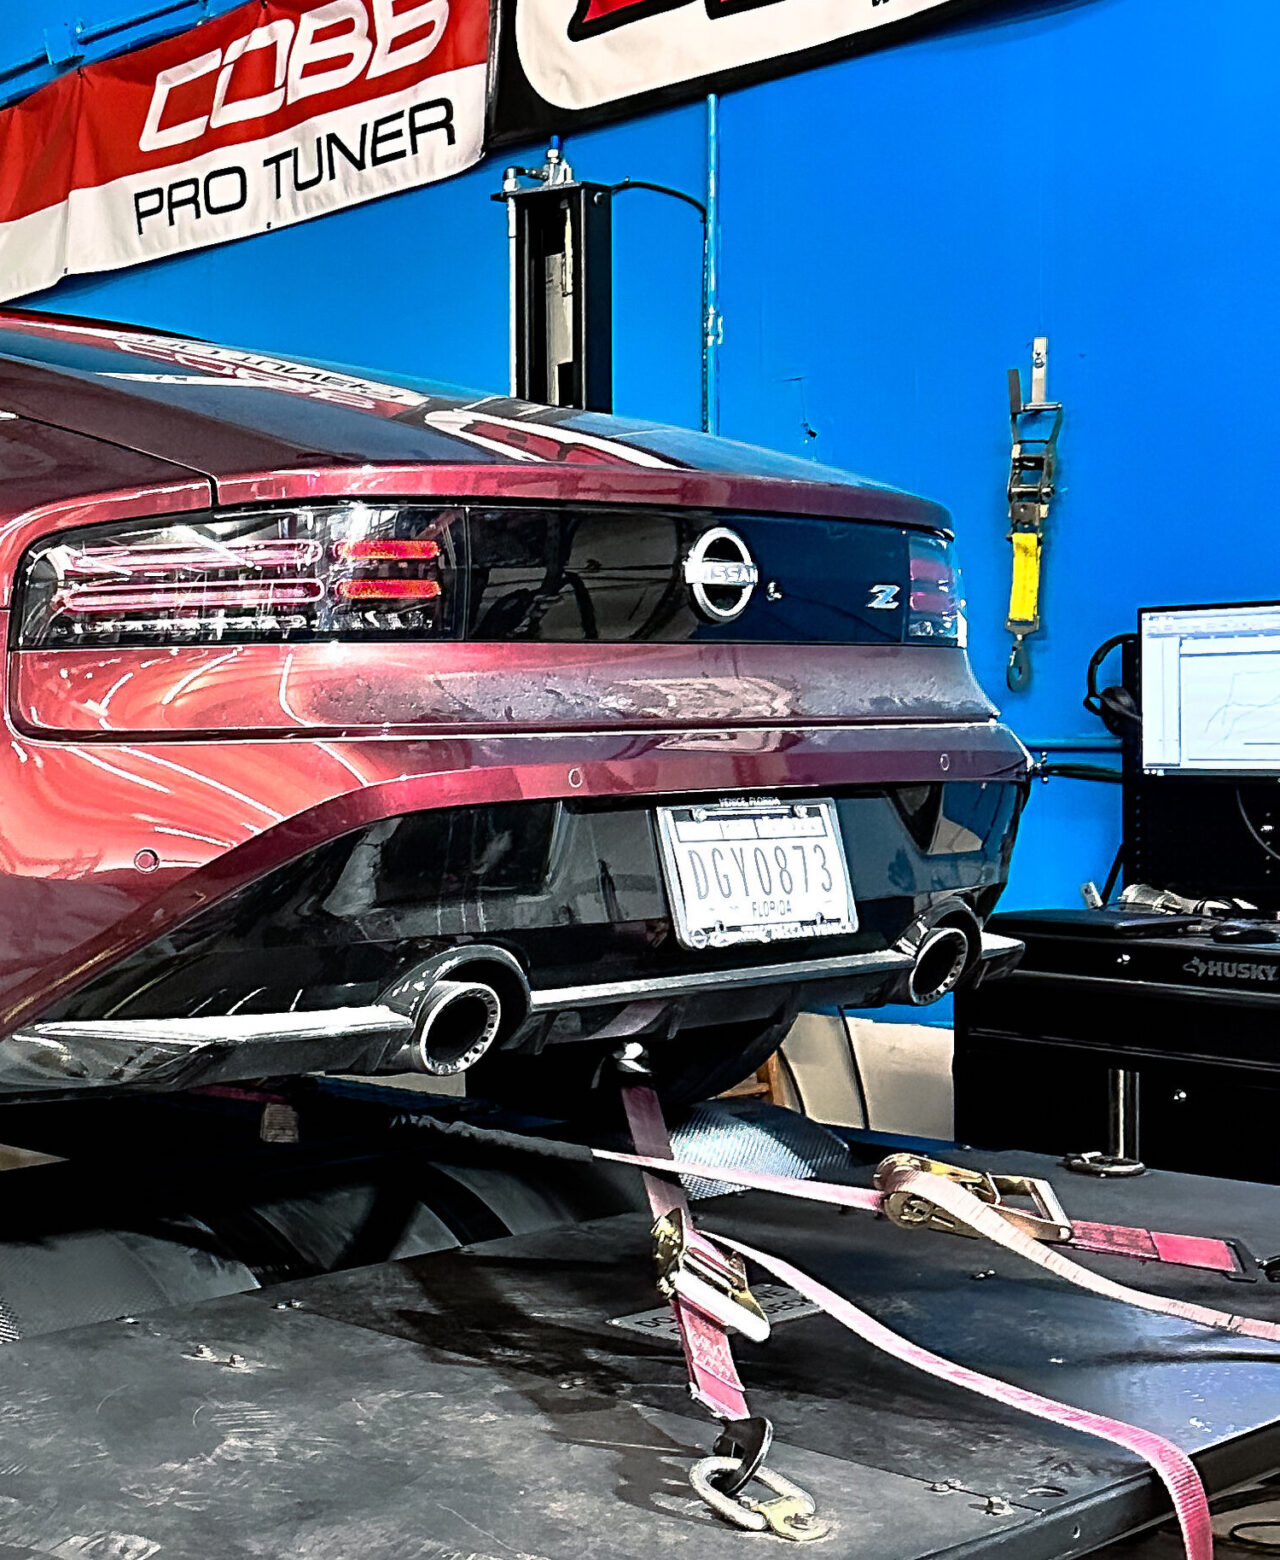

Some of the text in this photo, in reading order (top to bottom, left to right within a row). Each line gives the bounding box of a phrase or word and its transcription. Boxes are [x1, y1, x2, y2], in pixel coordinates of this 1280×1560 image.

[138, 0, 450, 152] COBB
[134, 97, 456, 235] PRO TUNER
[686, 561, 759, 586] ISSAN
[687, 844, 833, 900] DGY0873
[1207, 960, 1278, 981] HUSKY
